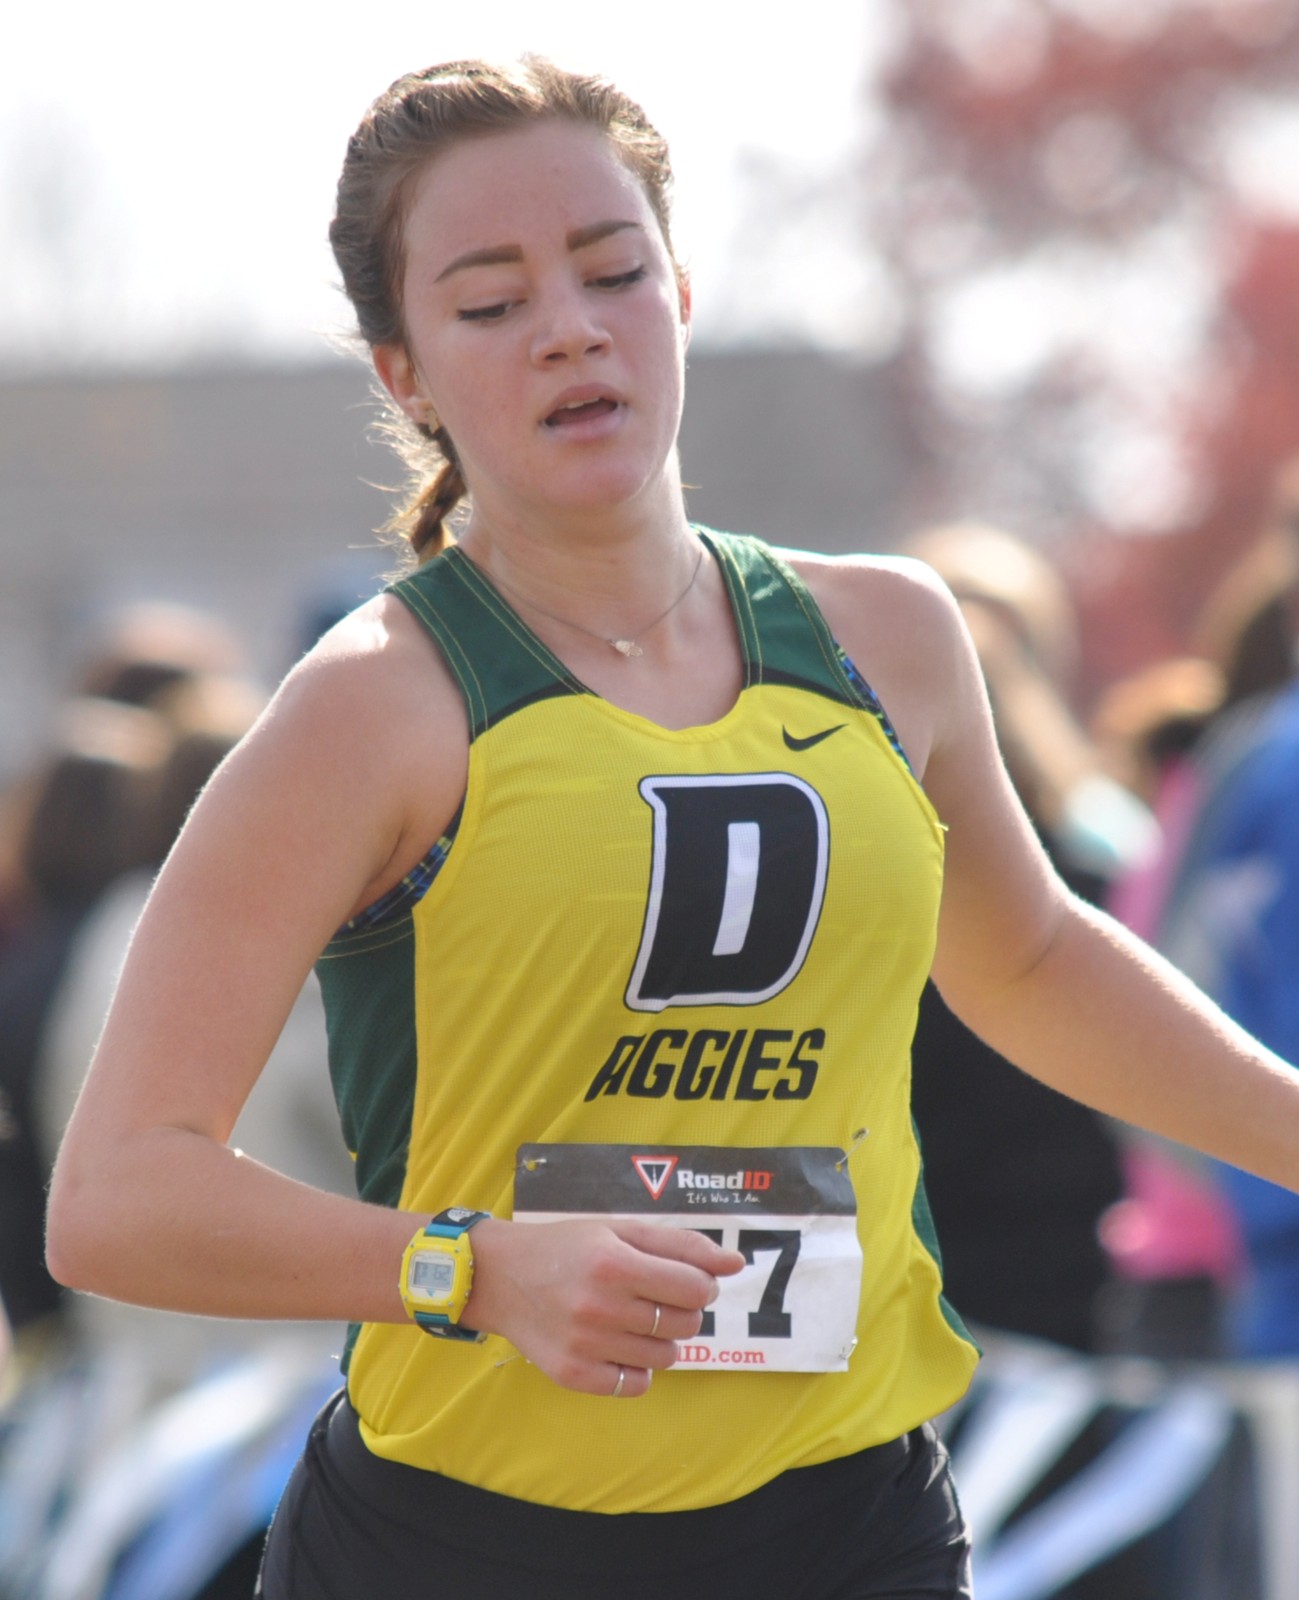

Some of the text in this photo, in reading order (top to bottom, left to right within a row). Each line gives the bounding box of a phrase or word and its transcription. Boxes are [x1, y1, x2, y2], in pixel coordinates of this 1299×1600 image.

[624, 771, 830, 1012] D
[584, 1027, 826, 1102] AGGIES
[677, 1170, 770, 1190] RoadID
